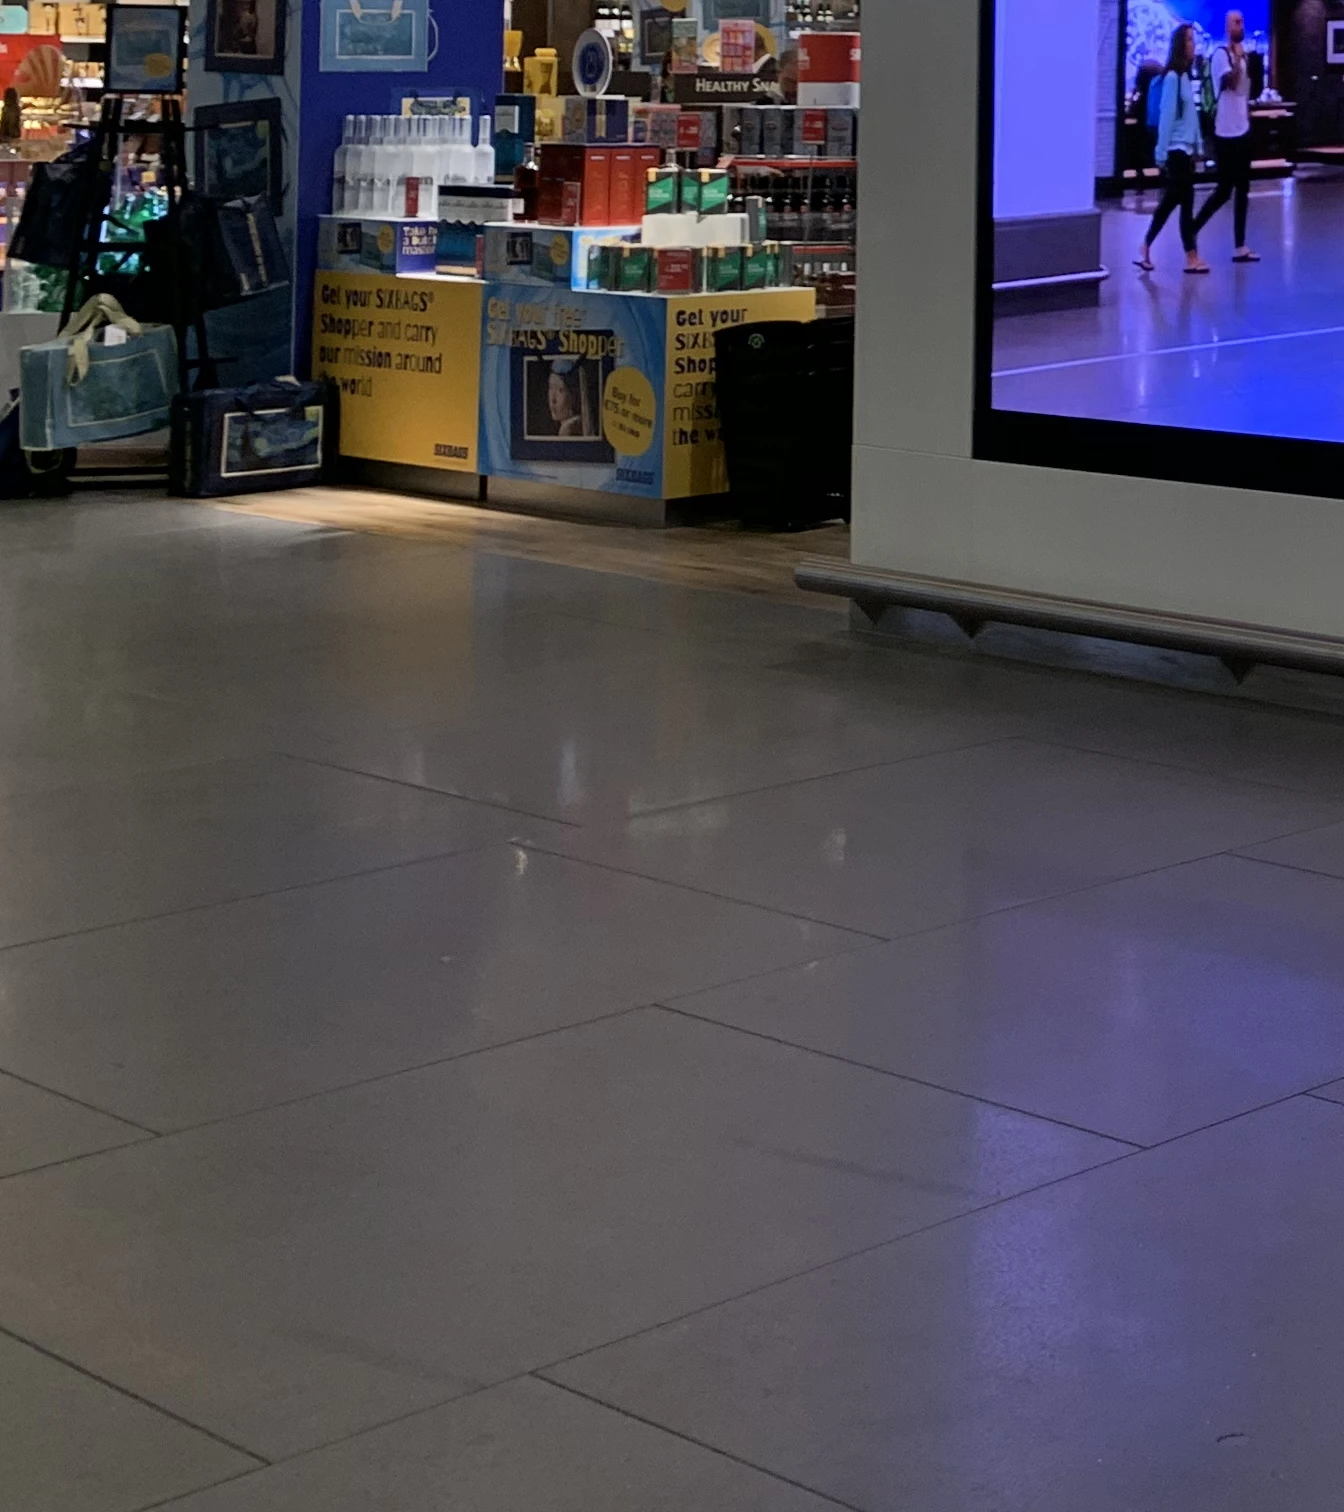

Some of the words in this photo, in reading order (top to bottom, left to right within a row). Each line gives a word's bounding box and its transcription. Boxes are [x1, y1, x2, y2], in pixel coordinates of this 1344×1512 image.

[695, 78, 750, 93] HEALTHY
[321, 285, 341, 305] Get
[345, 289, 372, 310] your
[676, 308, 704, 327] Get
[710, 308, 748, 327] your
[320, 314, 374, 340] Shopper
[378, 319, 400, 341] and
[404, 325, 439, 347] carry
[558, 329, 625, 359] Shopper
[675, 331, 716, 351] SIXB
[319, 345, 341, 364] our
[344, 346, 391, 370] mission
[395, 352, 443, 374] around
[674, 356, 716, 375] Shop
[673, 403, 716, 422] miss
[673, 427, 700, 446] the
